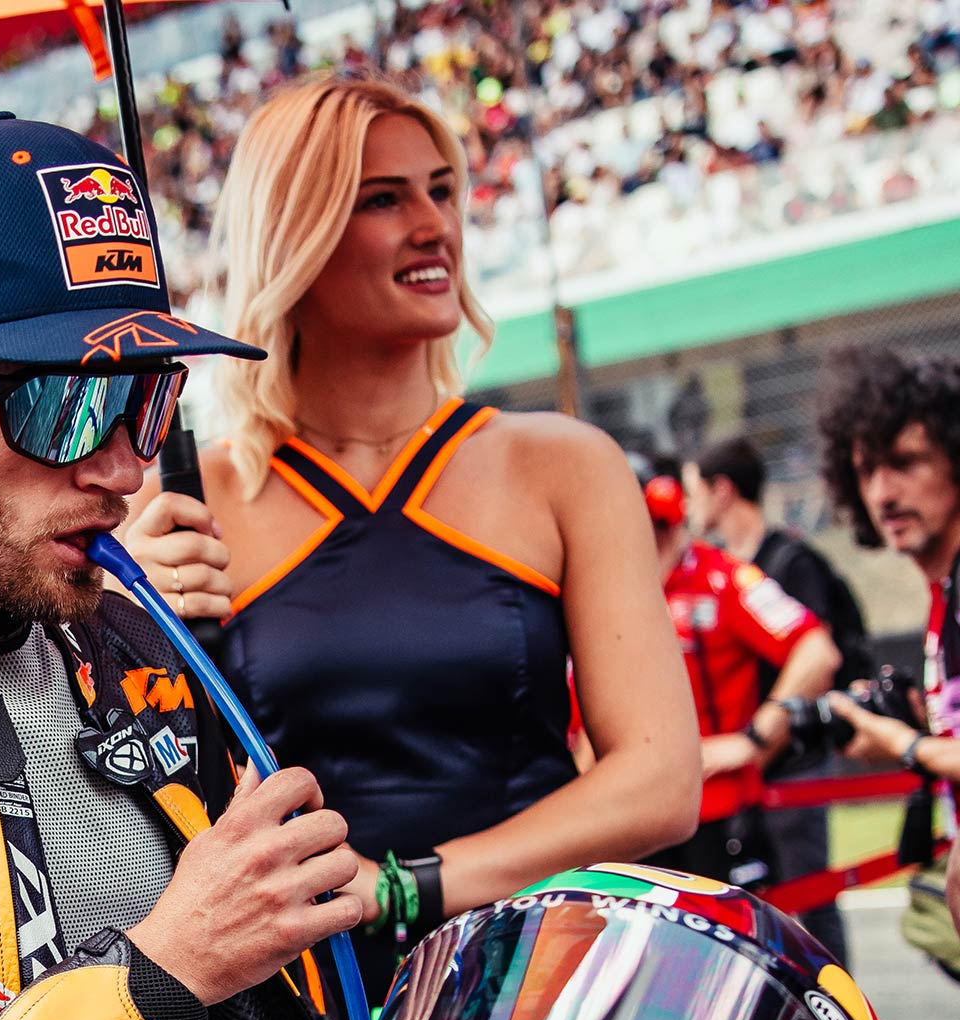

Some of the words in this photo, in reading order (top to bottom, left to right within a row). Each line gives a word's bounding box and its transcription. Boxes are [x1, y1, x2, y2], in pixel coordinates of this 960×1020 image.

[58, 205, 115, 239] Red
[113, 207, 150, 240] Bull
[95, 249, 143, 272] KTM
[9, 807, 30, 817] 2215
[491, 894, 567, 914] YOU
[591, 894, 737, 942] WINGS
